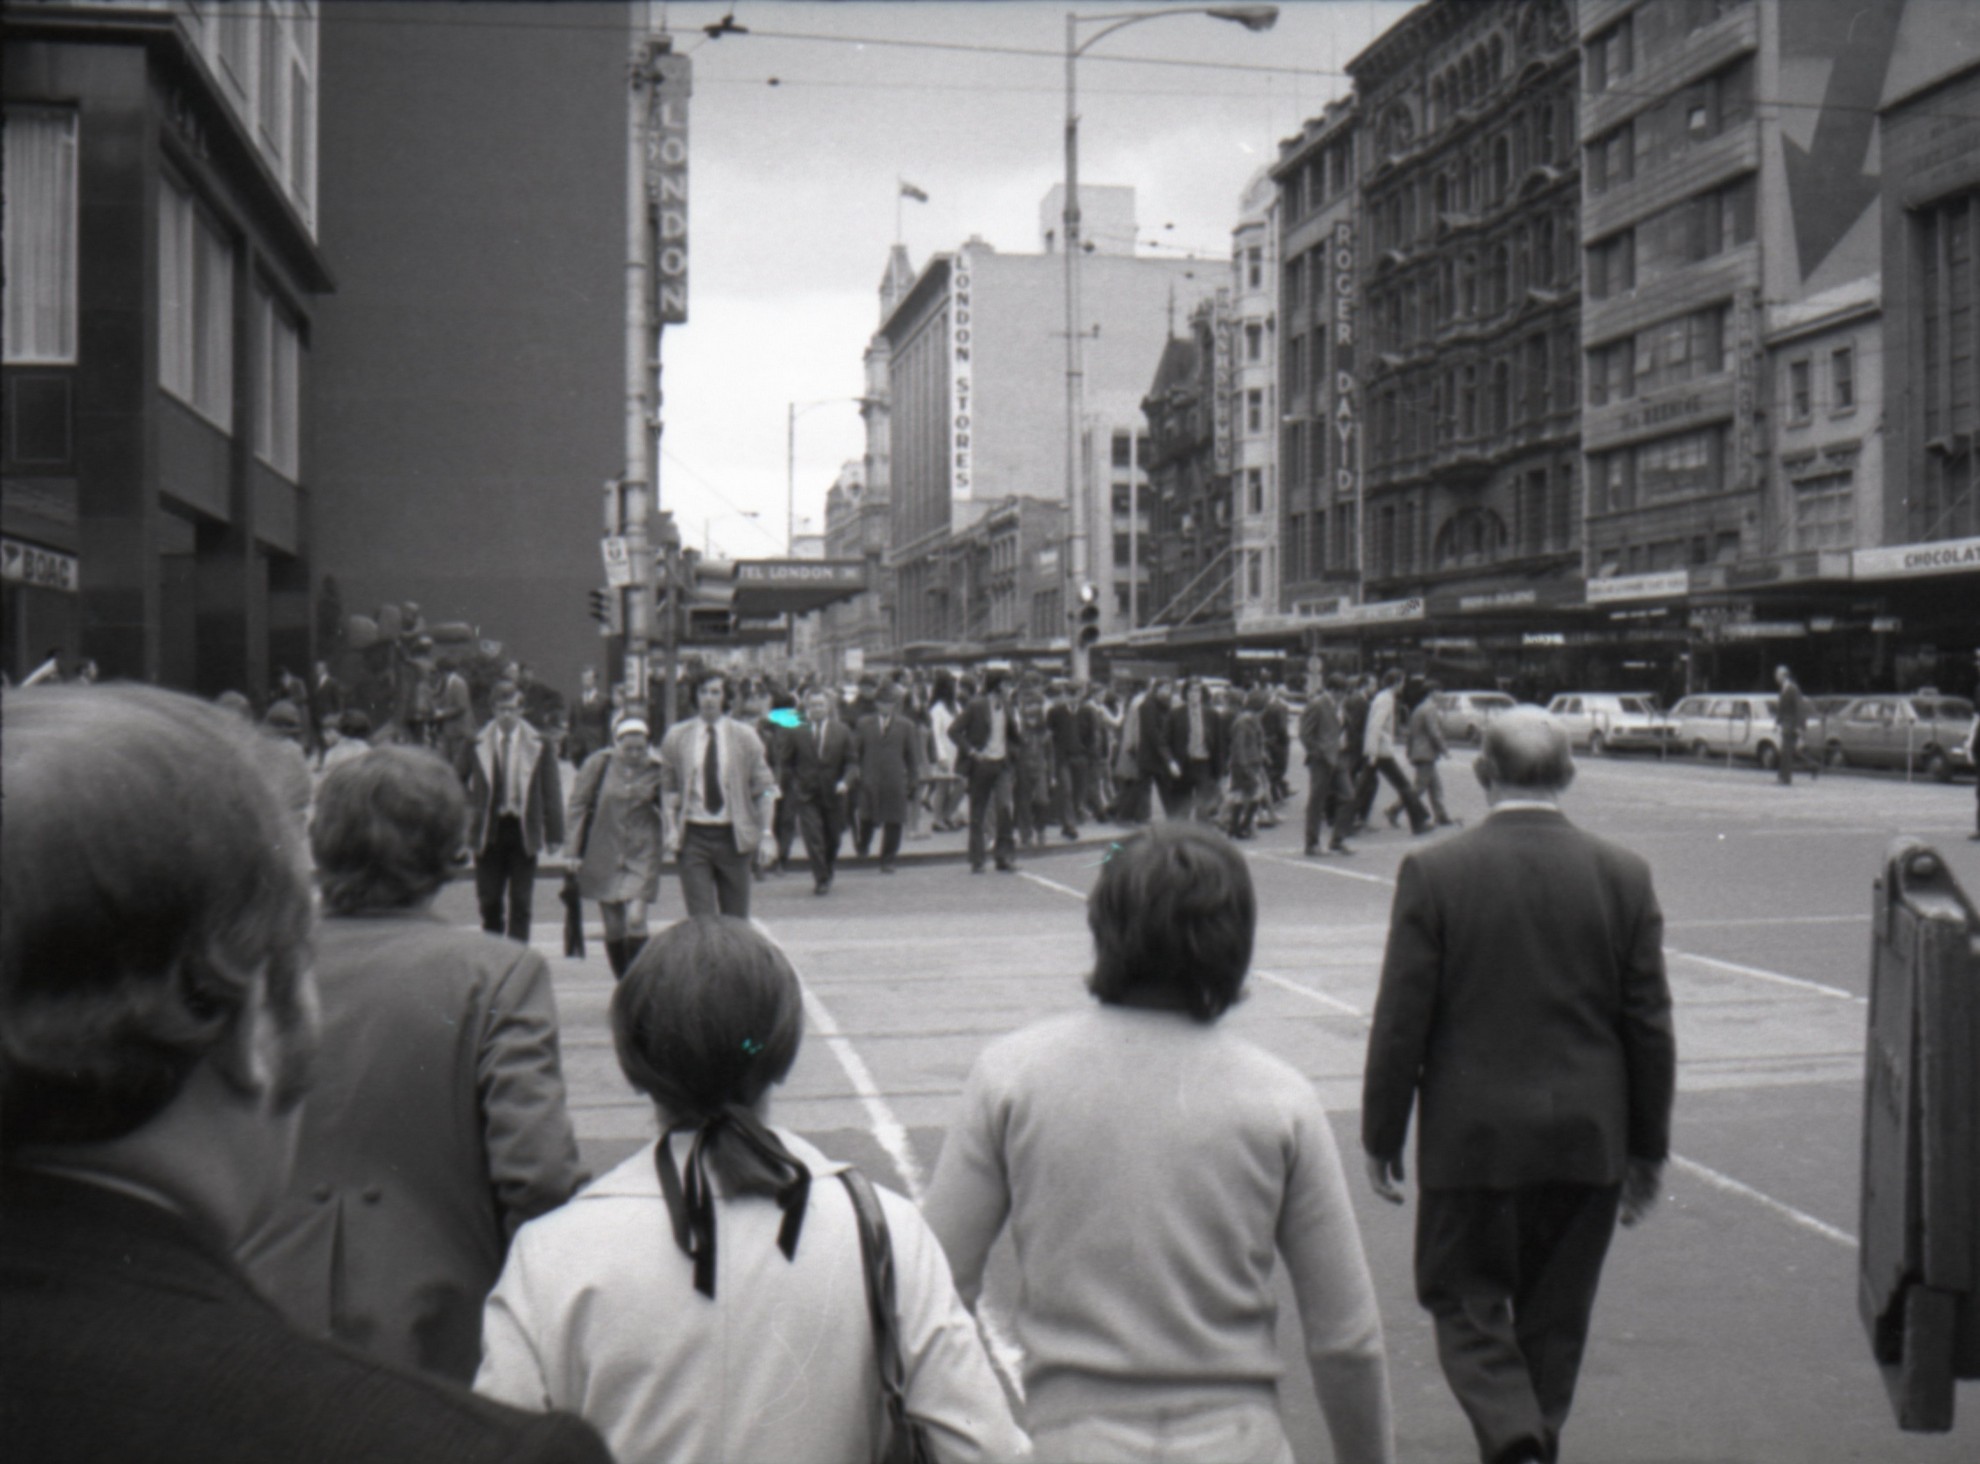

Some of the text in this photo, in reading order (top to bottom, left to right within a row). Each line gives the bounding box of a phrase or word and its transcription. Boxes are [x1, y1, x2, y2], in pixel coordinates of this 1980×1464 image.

[660, 103, 686, 313] LONDON
[955, 255, 970, 489] LONDON STORES
[1337, 223, 1352, 492] ROGER DAVID
[770, 566, 833, 580] LONDON
